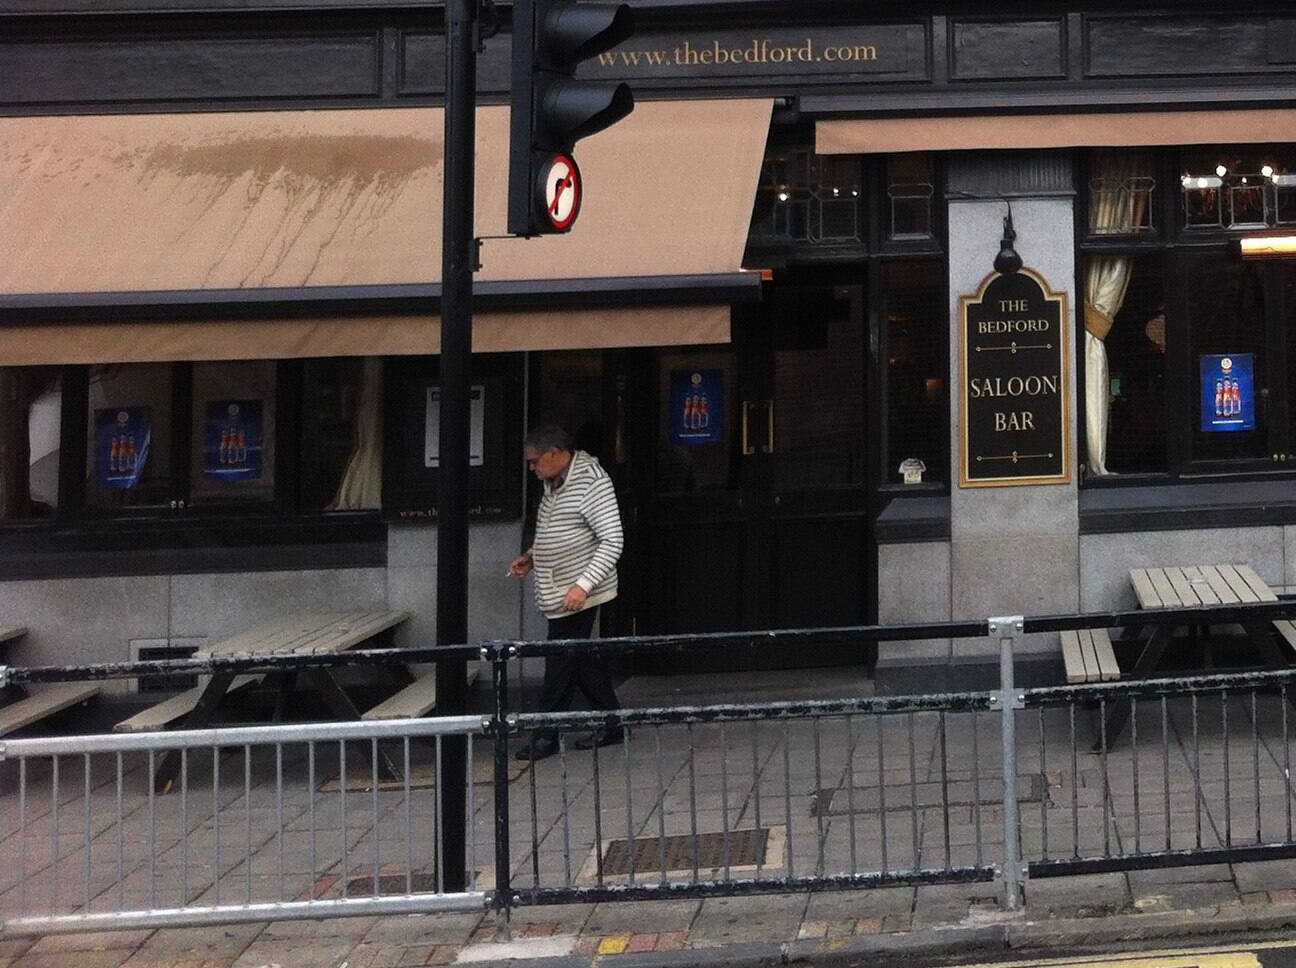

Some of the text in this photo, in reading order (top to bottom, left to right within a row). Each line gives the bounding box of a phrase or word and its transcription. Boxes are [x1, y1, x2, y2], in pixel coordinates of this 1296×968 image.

[598, 39, 879, 68] www.thebedford.com
[998, 299, 1029, 313] THE
[978, 319, 1050, 334] BEDFORD
[970, 375, 1059, 399] SALOON
[994, 411, 1036, 432] BAR
